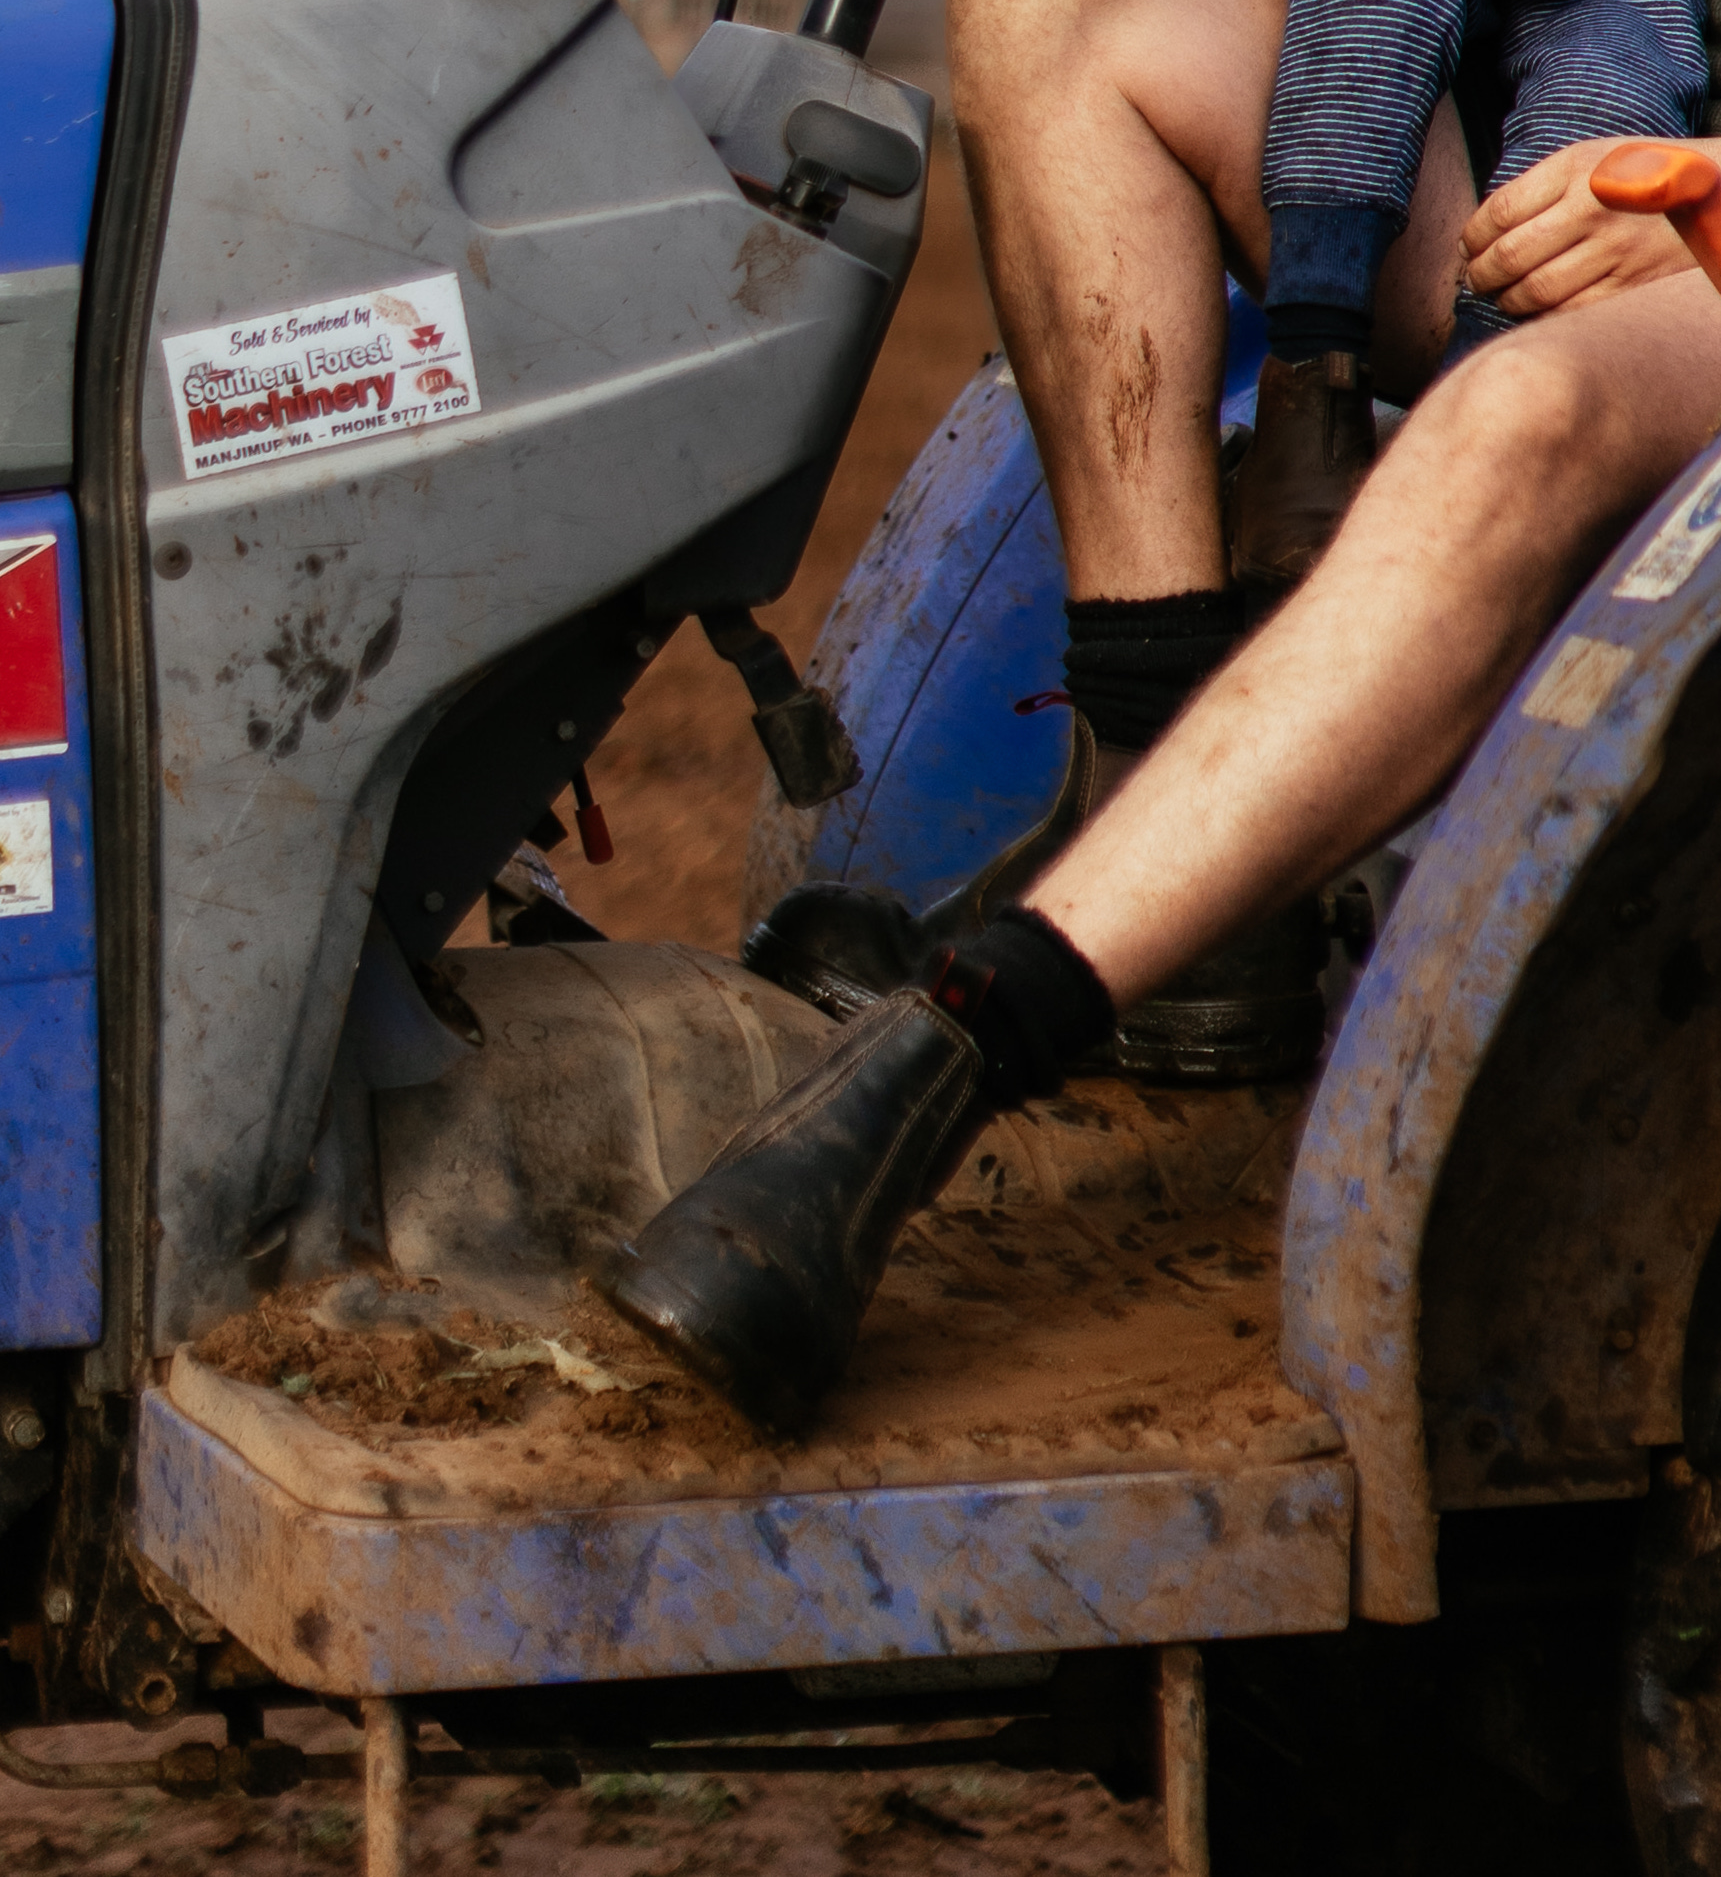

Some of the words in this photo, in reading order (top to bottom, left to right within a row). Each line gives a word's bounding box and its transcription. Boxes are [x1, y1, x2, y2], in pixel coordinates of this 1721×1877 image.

[229, 328, 267, 356] Sold
[271, 325, 284, 344] &
[285, 309, 350, 344] Serviced
[183, 359, 303, 408] Southern
[306, 334, 394, 379] Forest
[188, 371, 397, 448] Machinery
[195, 439, 283, 470] MANJIMUP
[285, 432, 313, 448] WA
[331, 415, 388, 438] PHONE
[391, 404, 428, 424] 9777
[433, 394, 470, 414] 2100
